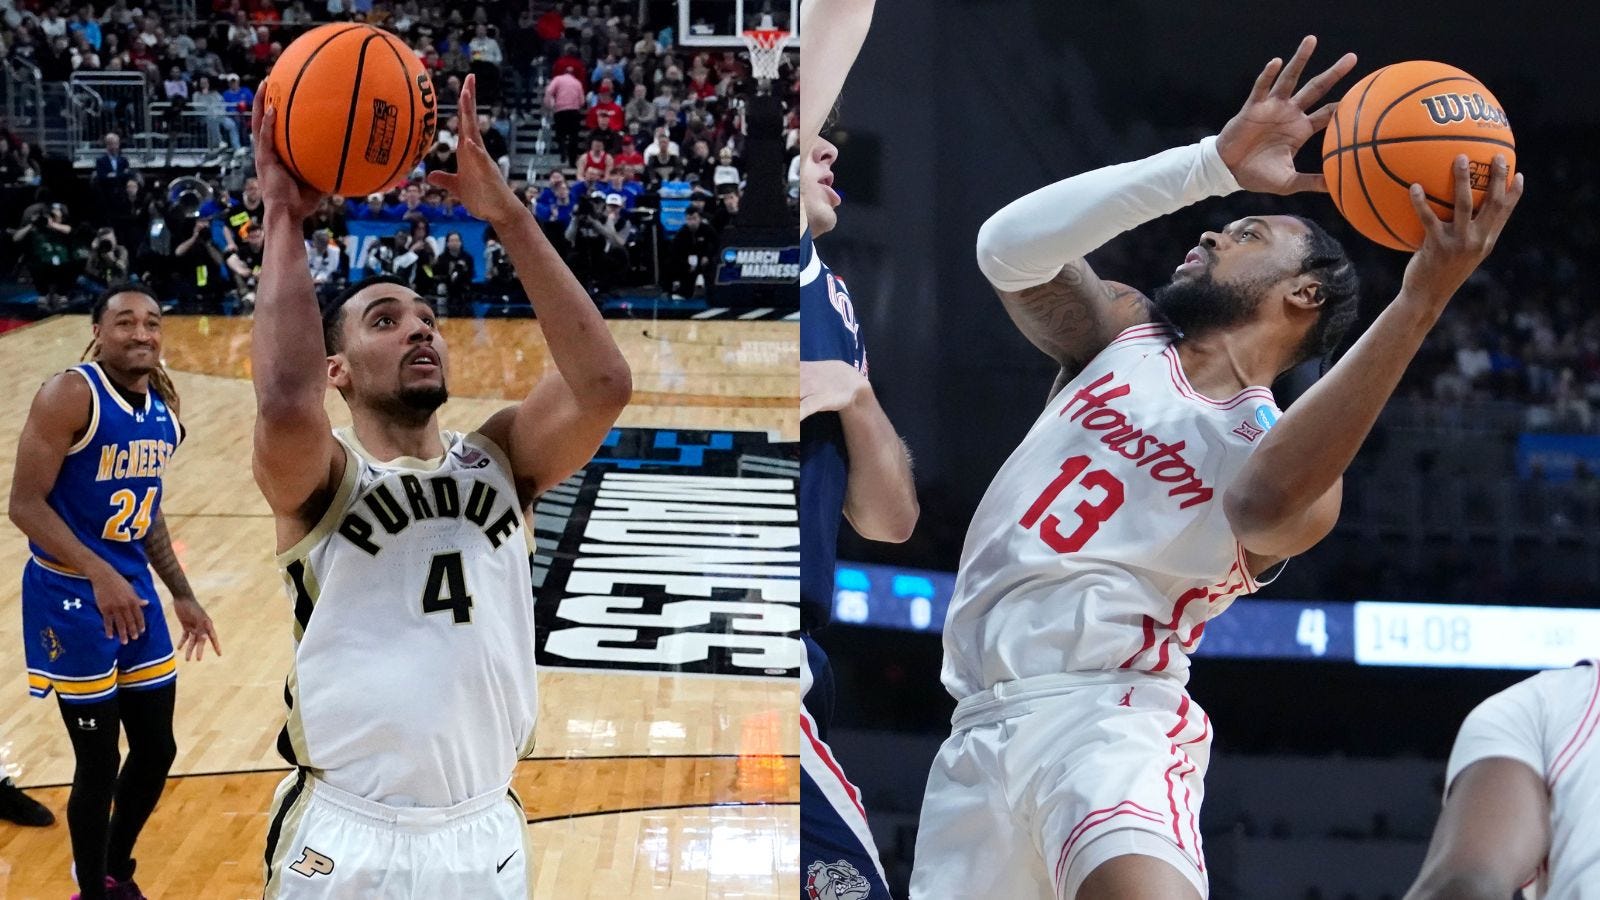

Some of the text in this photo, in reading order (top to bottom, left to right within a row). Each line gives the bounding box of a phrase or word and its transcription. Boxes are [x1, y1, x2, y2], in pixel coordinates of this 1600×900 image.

[735, 250, 780, 265] MARCH
[741, 263, 800, 278] MADNESS
[1058, 371, 1214, 510] Houston
[101, 486, 158, 542] 24
[337, 473, 521, 559] PURDUE
[1018, 455, 1125, 553] 13
[422, 551, 474, 626] 4
[544, 472, 800, 669] MADNESS
[1296, 608, 1328, 656] 4
[288, 845, 335, 878] P
